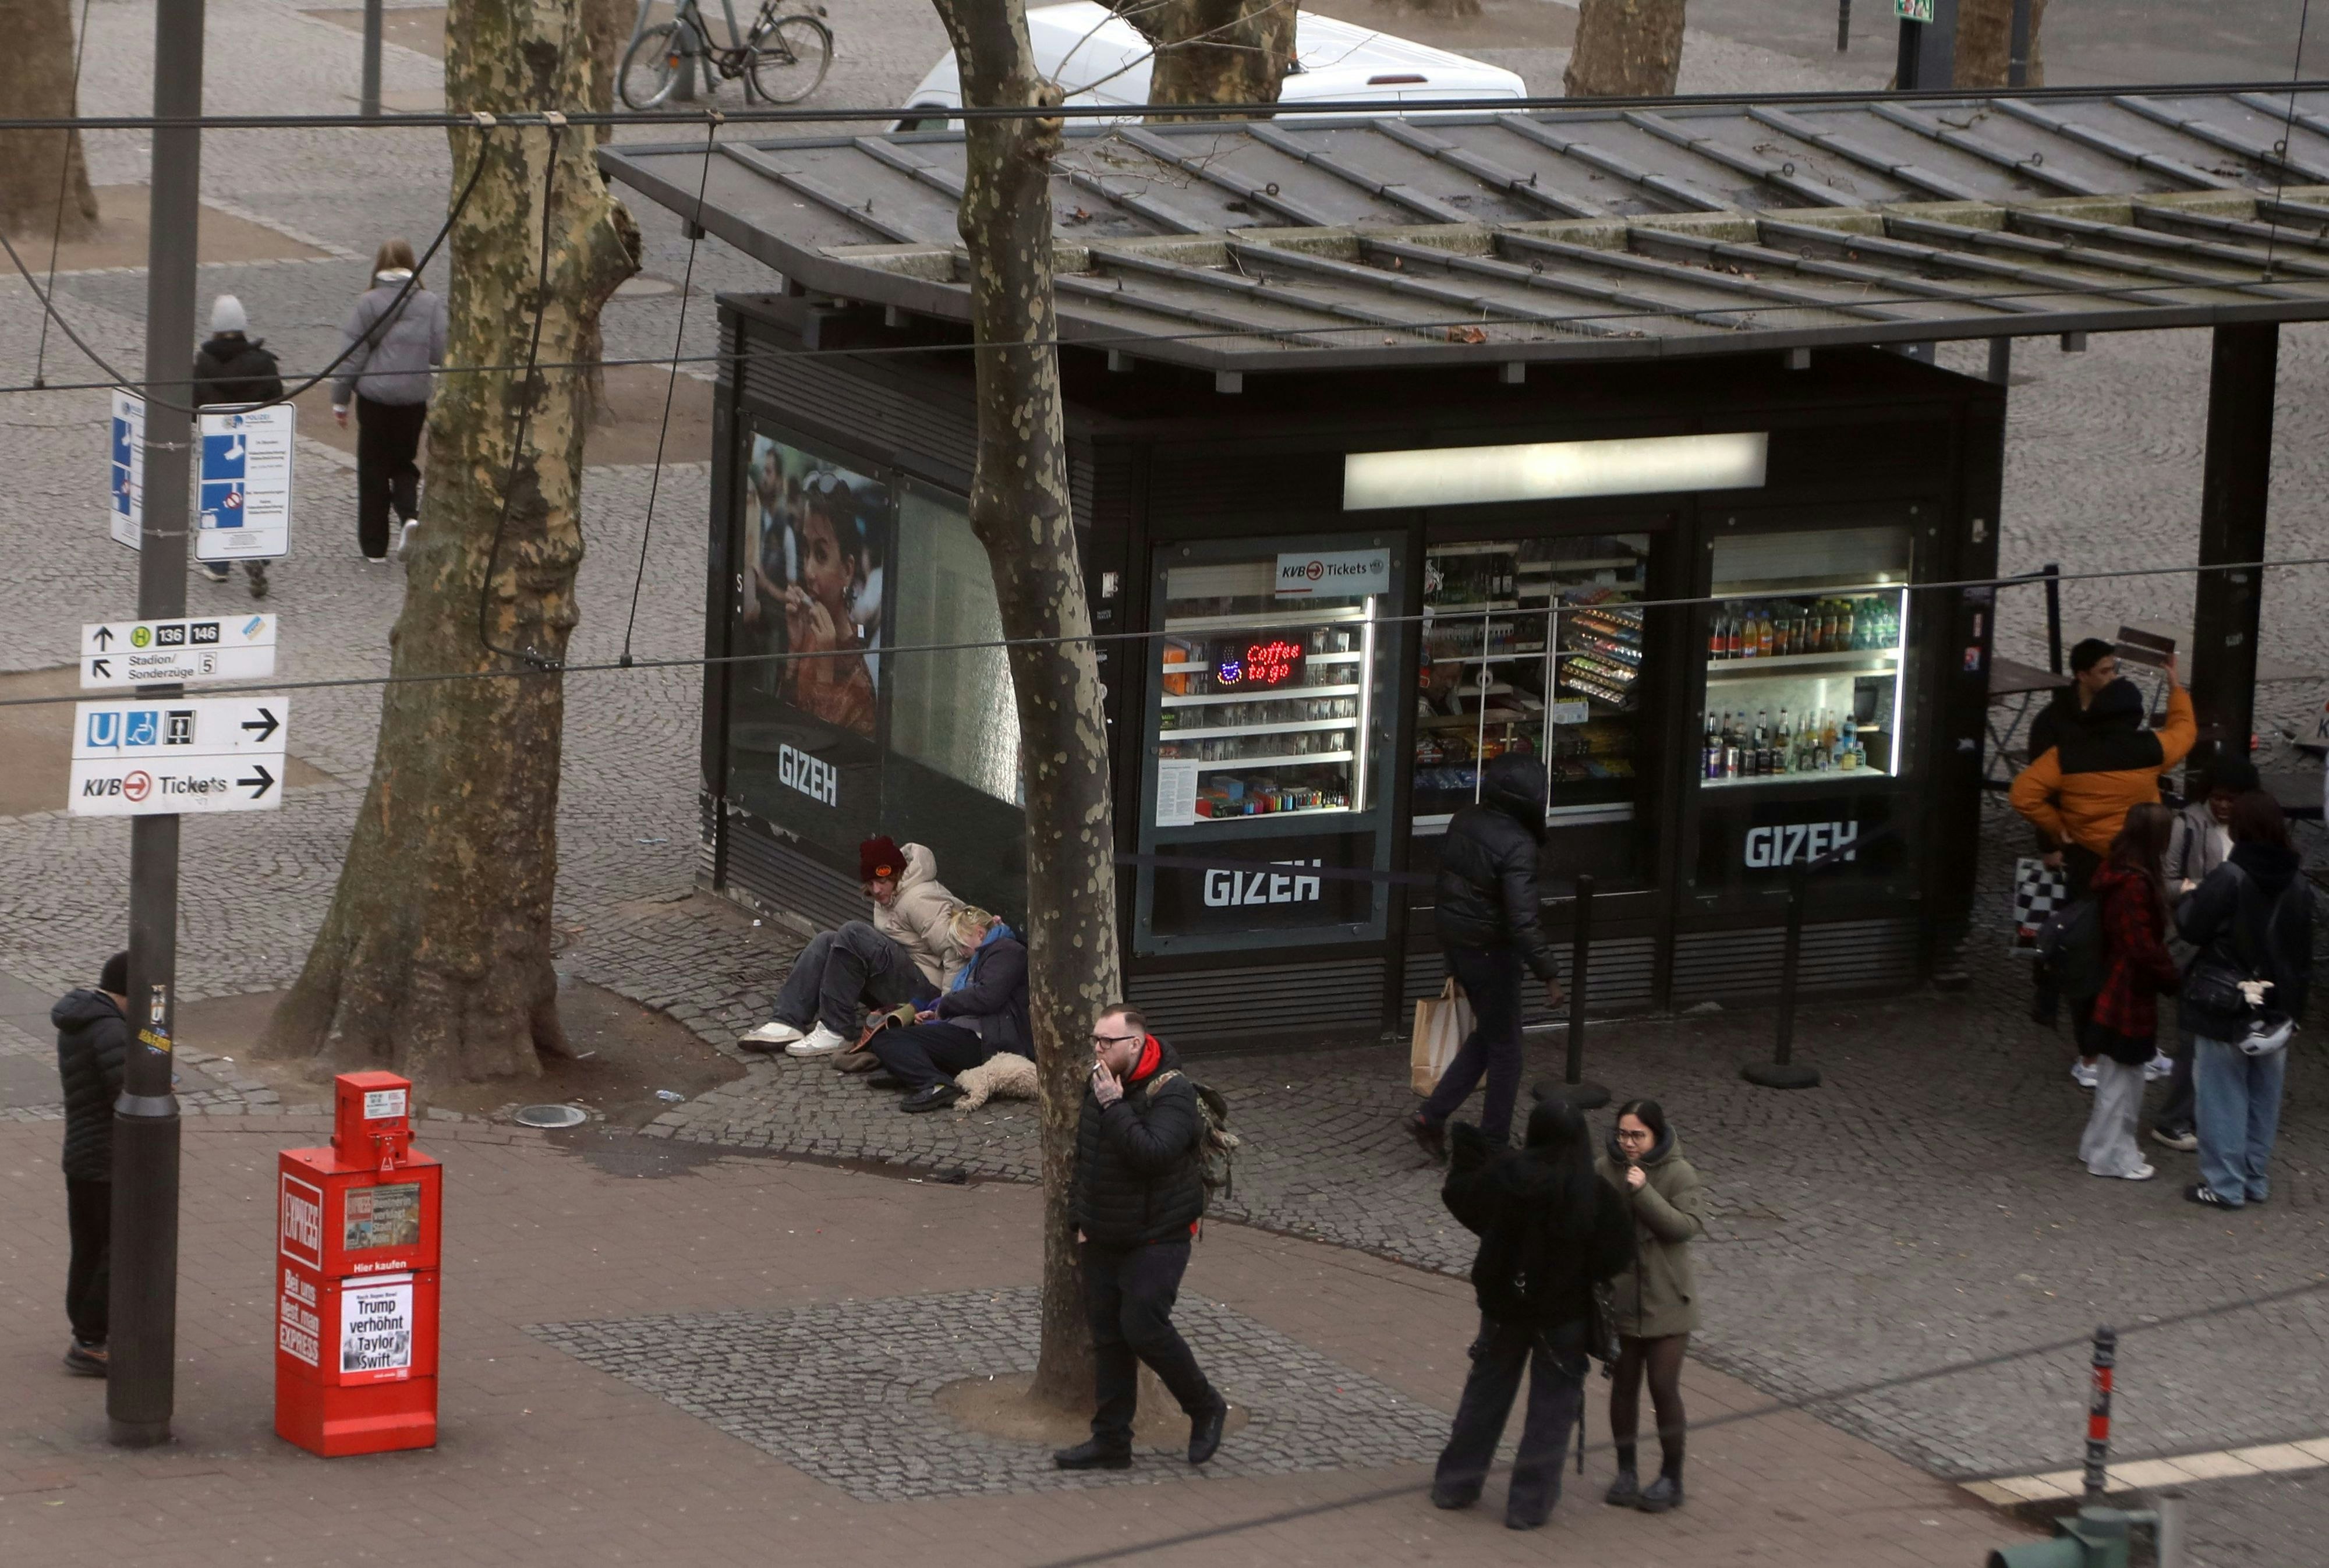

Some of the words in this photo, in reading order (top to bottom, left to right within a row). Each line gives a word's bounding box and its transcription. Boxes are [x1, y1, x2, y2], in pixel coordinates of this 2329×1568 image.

[1282, 566, 1305, 578] KVB
[1327, 563, 1367, 575] Tickets
[158, 629, 183, 642] 136
[193, 626, 217, 640] 146
[129, 653, 176, 666] Stadion/
[1247, 641, 1301, 666] Coffee
[128, 667, 194, 680] Sonderzüge
[203, 659, 212, 672] 5
[1248, 664, 1265, 680] to
[1268, 664, 1290, 684] go
[90, 714, 116, 745] U
[779, 744, 837, 807] GIZEH
[83, 778, 122, 796] KVB
[159, 776, 226, 794] Tickets
[1204, 859, 1322, 907] GIZEH
[285, 1192, 318, 1251] EXPRESS
[353, 1263, 373, 1273] Hier
[375, 1259, 407, 1270] kaufen
[285, 1268, 299, 1293] Bei
[300, 1281, 316, 1302] uns
[281, 1294, 299, 1322] liest
[300, 1309, 319, 1332] man
[358, 1300, 396, 1314] Trump
[350, 1315, 403, 1333] verhöhnt
[279, 1323, 319, 1361] EXPRESS
[358, 1335, 395, 1352] Taylor
[359, 1352, 391, 1369] Swift
